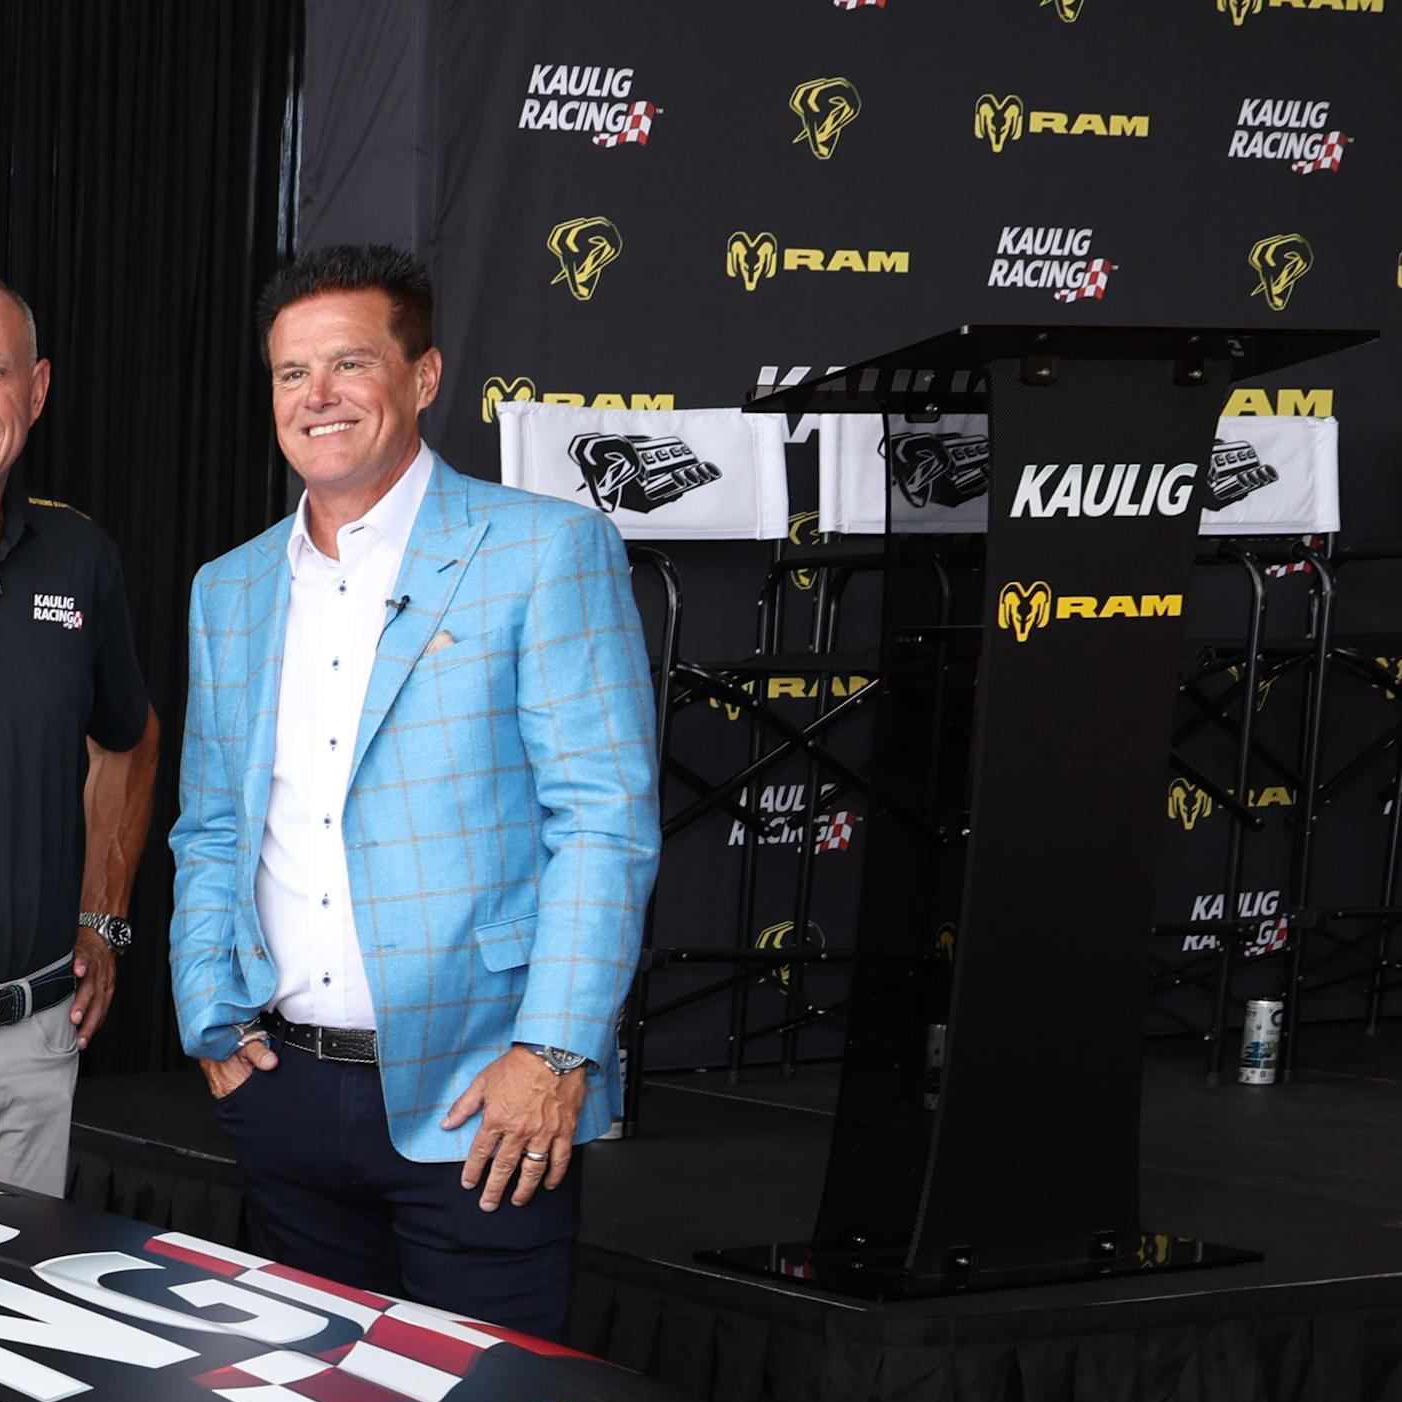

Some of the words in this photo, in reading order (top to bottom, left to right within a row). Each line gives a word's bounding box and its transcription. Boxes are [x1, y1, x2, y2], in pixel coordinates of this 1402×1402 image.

[528, 65, 633, 97] KAULIG
[519, 99, 628, 130] RACING
[1030, 112, 1149, 136] RAM
[1238, 99, 1329, 128] KAULIG
[1228, 130, 1323, 159] RACING
[997, 227, 1092, 256] KAULIG
[784, 249, 910, 272] RAM
[988, 259, 1084, 287] RACING
[1221, 388, 1334, 416] AM
[1010, 463, 1197, 517] KAULIG
[34, 594, 74, 609] KAULIG
[34, 608, 75, 621] RACING
[1057, 595, 1182, 618] RAM
